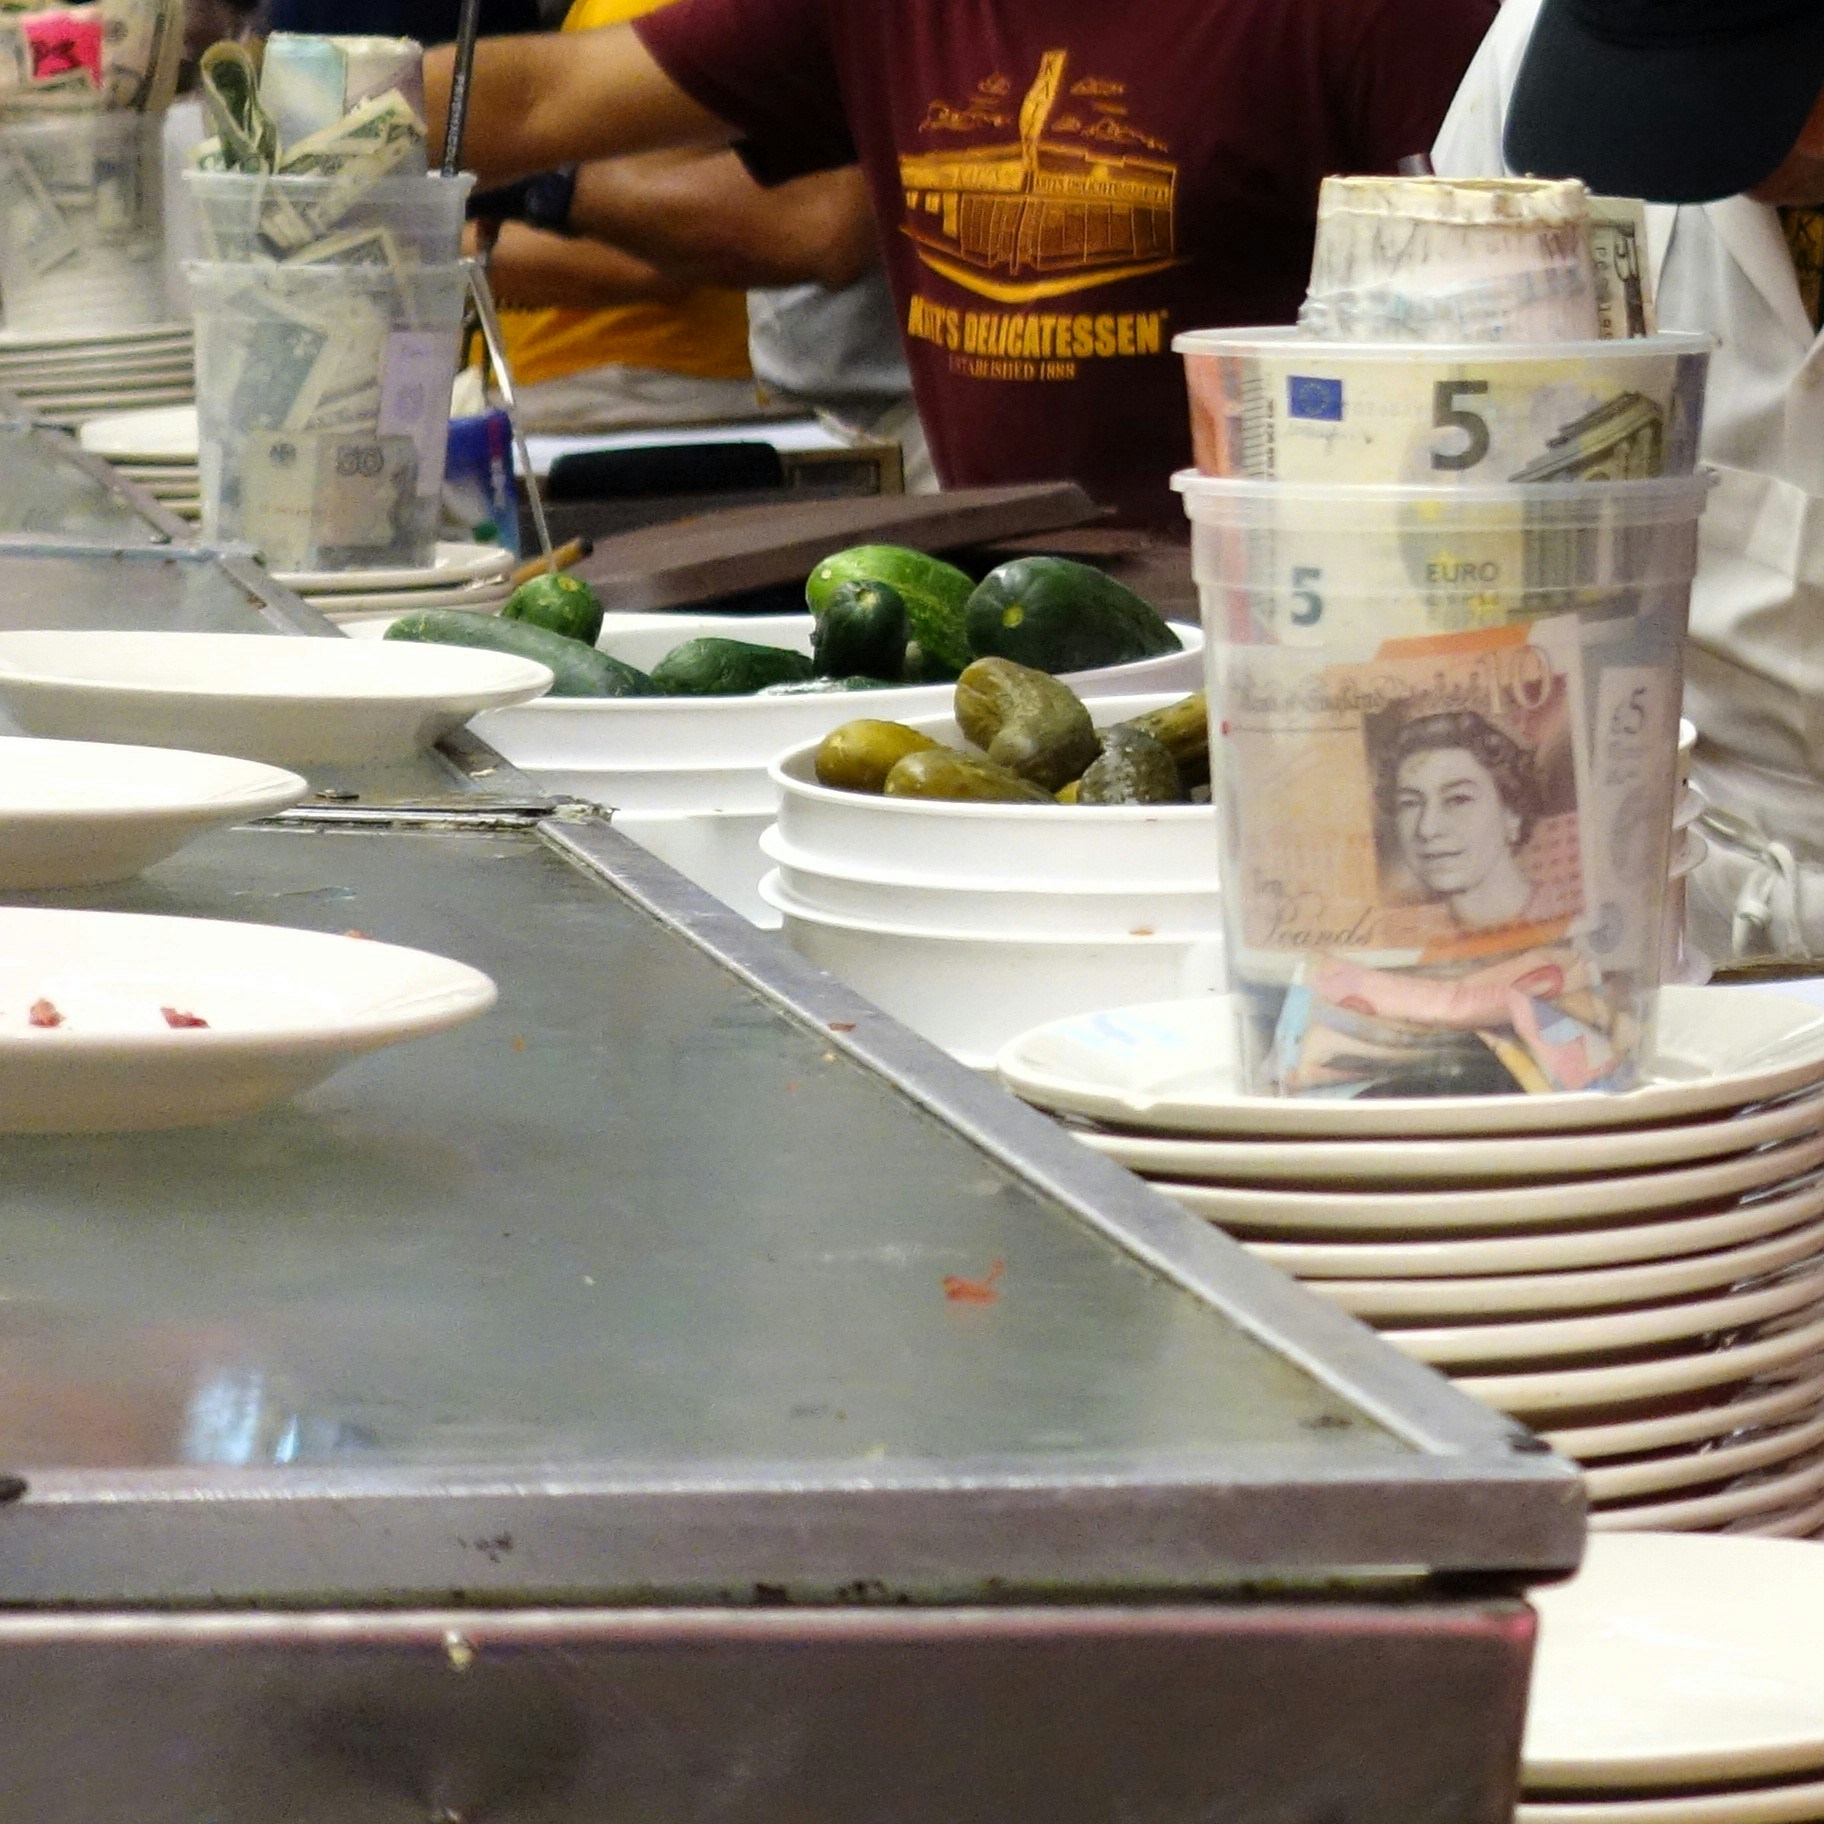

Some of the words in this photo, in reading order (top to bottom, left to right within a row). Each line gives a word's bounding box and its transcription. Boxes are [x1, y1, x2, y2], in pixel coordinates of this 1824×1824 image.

[963, 312, 1161, 360] DELICATESSEN
[1040, 360, 1077, 382] 1888
[1429, 379, 1490, 472] 5
[1425, 560, 1499, 584] EURO
[1288, 566, 1323, 627] 5
